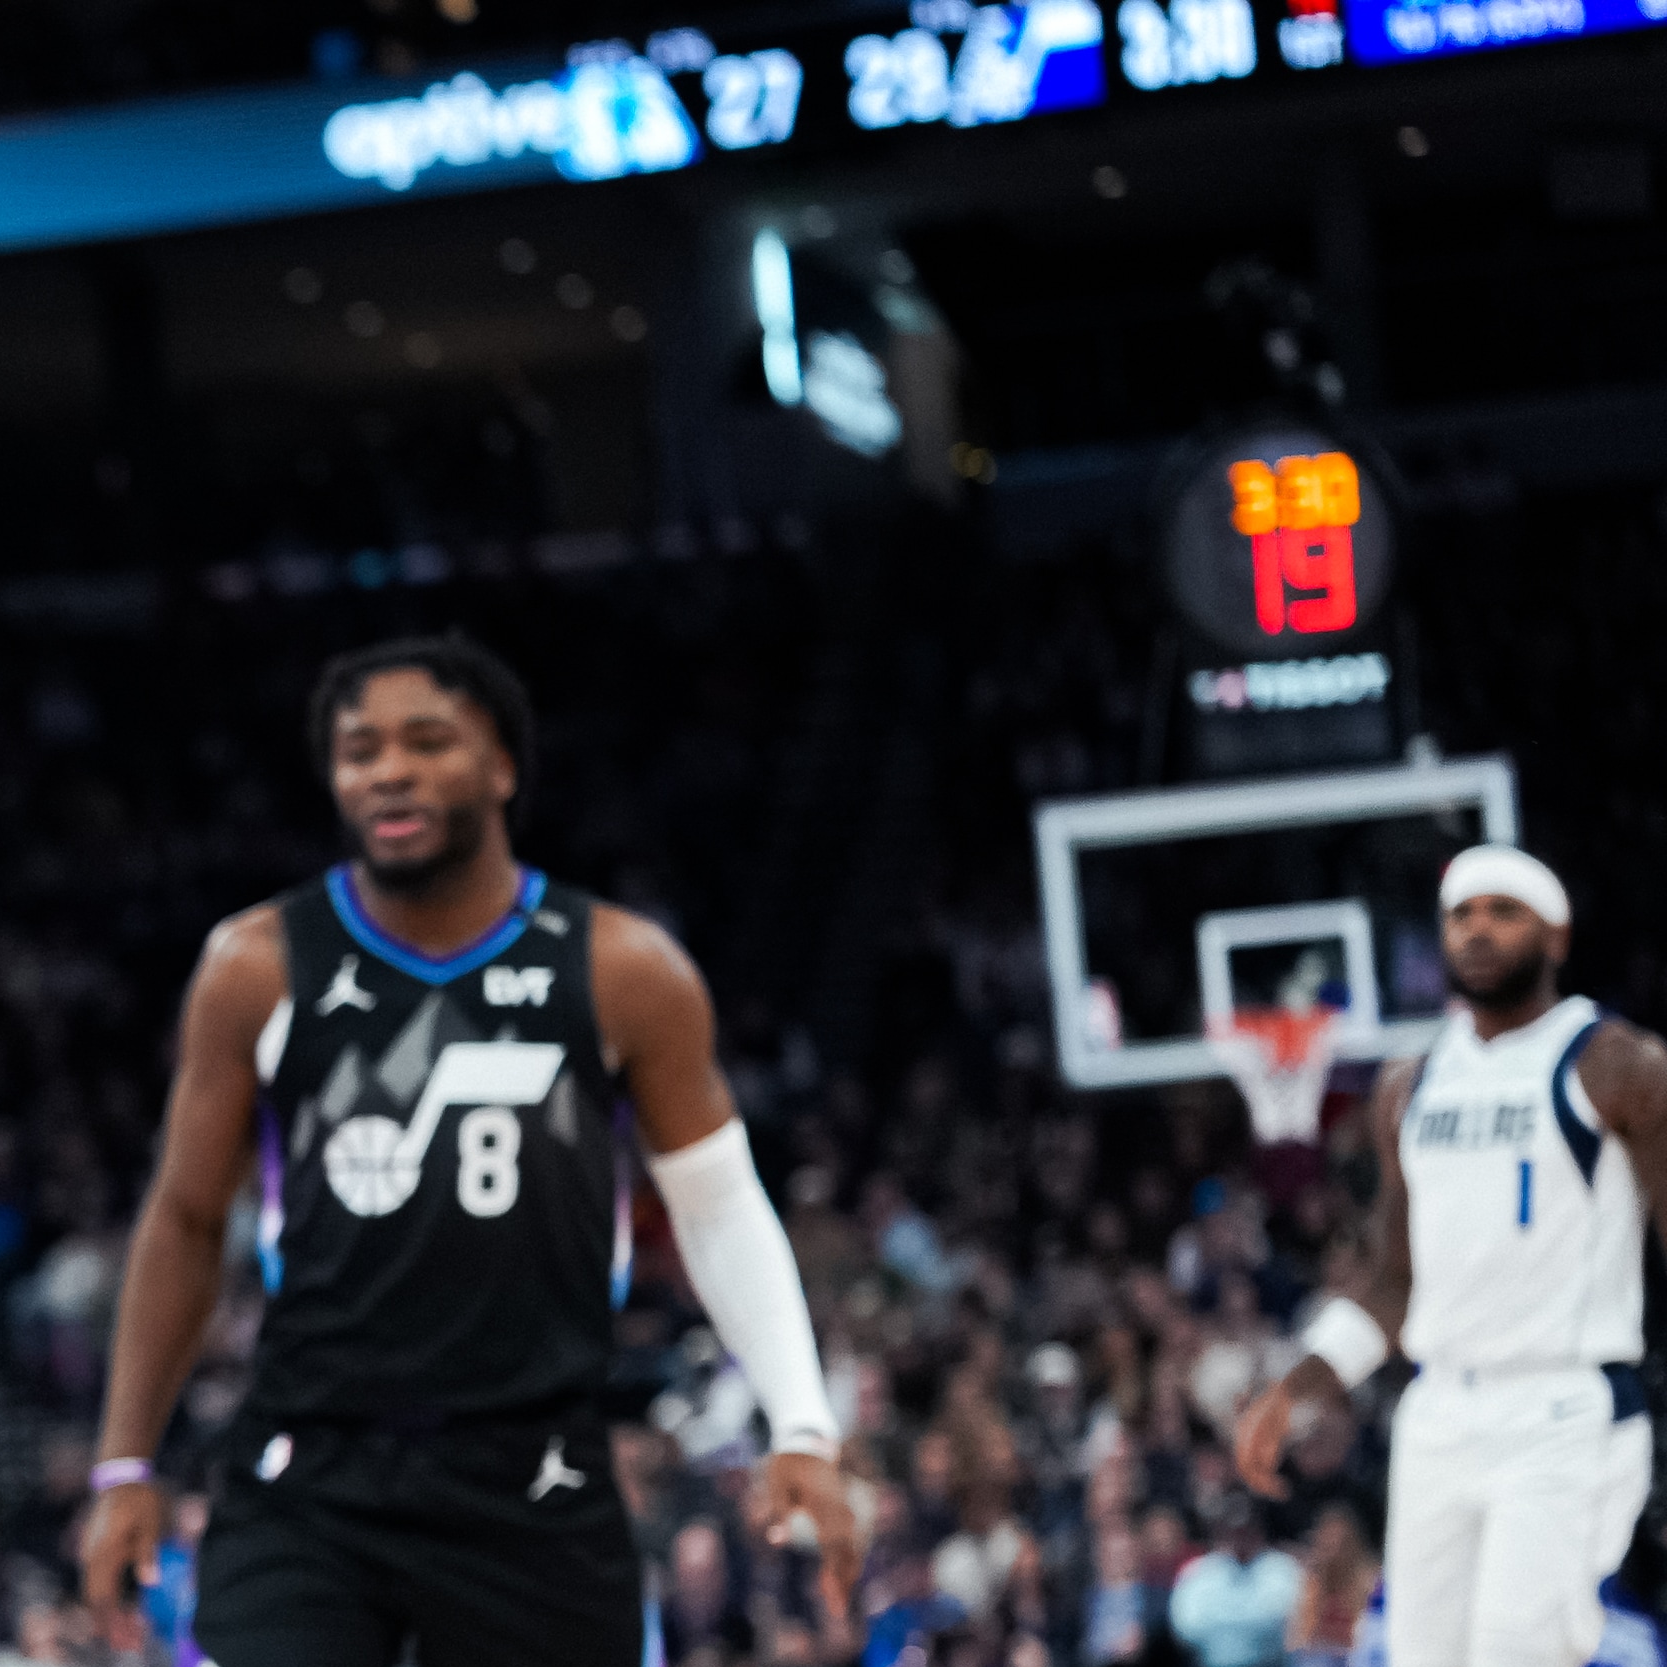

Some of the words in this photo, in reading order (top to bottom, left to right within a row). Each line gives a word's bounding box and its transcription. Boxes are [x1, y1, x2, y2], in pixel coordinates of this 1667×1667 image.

[1251, 524, 1358, 636] 19
[457, 1107, 521, 1218] 8
[1516, 1159, 1531, 1228] 1
